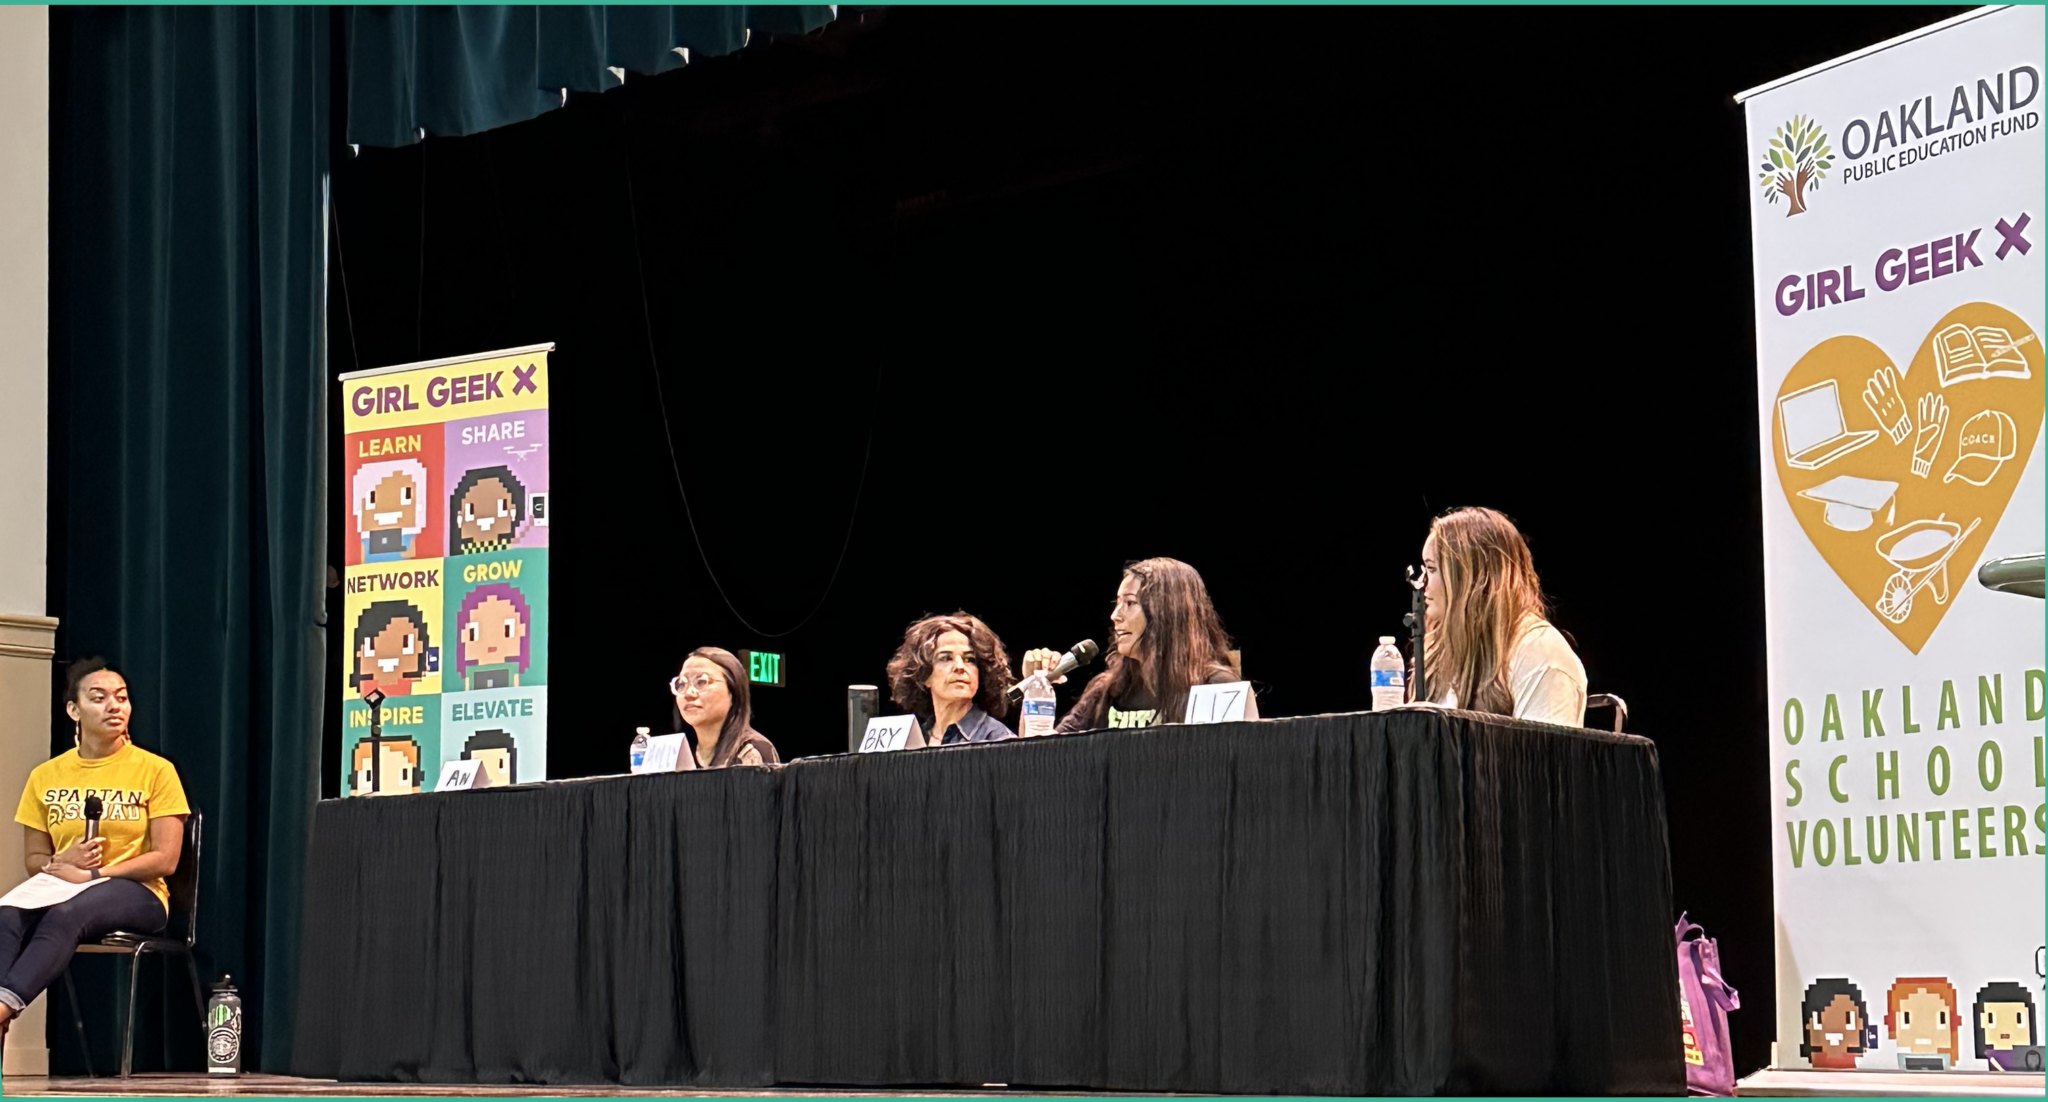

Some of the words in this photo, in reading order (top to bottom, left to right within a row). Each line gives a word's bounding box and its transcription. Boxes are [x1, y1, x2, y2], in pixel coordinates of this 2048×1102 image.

[1842, 65, 2039, 160] OAKLAND
[1843, 155, 1896, 184] PUBLIC
[1899, 125, 1987, 168] EDUCATION
[1991, 111, 2039, 139] FUND
[1775, 265, 1866, 316] GIRL
[1875, 228, 1984, 292] GEEK
[352, 384, 419, 417] GIRL
[426, 370, 505, 408] GEEK
[461, 420, 525, 445] SHARE
[1961, 433, 1995, 446] COACH
[359, 435, 421, 458] LEARN
[347, 569, 439, 594] NETWORK
[463, 560, 522, 583] GROW
[750, 651, 780, 684] EXIT
[452, 699, 533, 722] ELEVATE
[1783, 669, 2045, 745] OAKLAND
[864, 728, 902, 750] BRY
[1785, 736, 2045, 807] SCHOOL
[45, 789, 142, 803] SPARTAN
[64, 803, 140, 820] SAD
